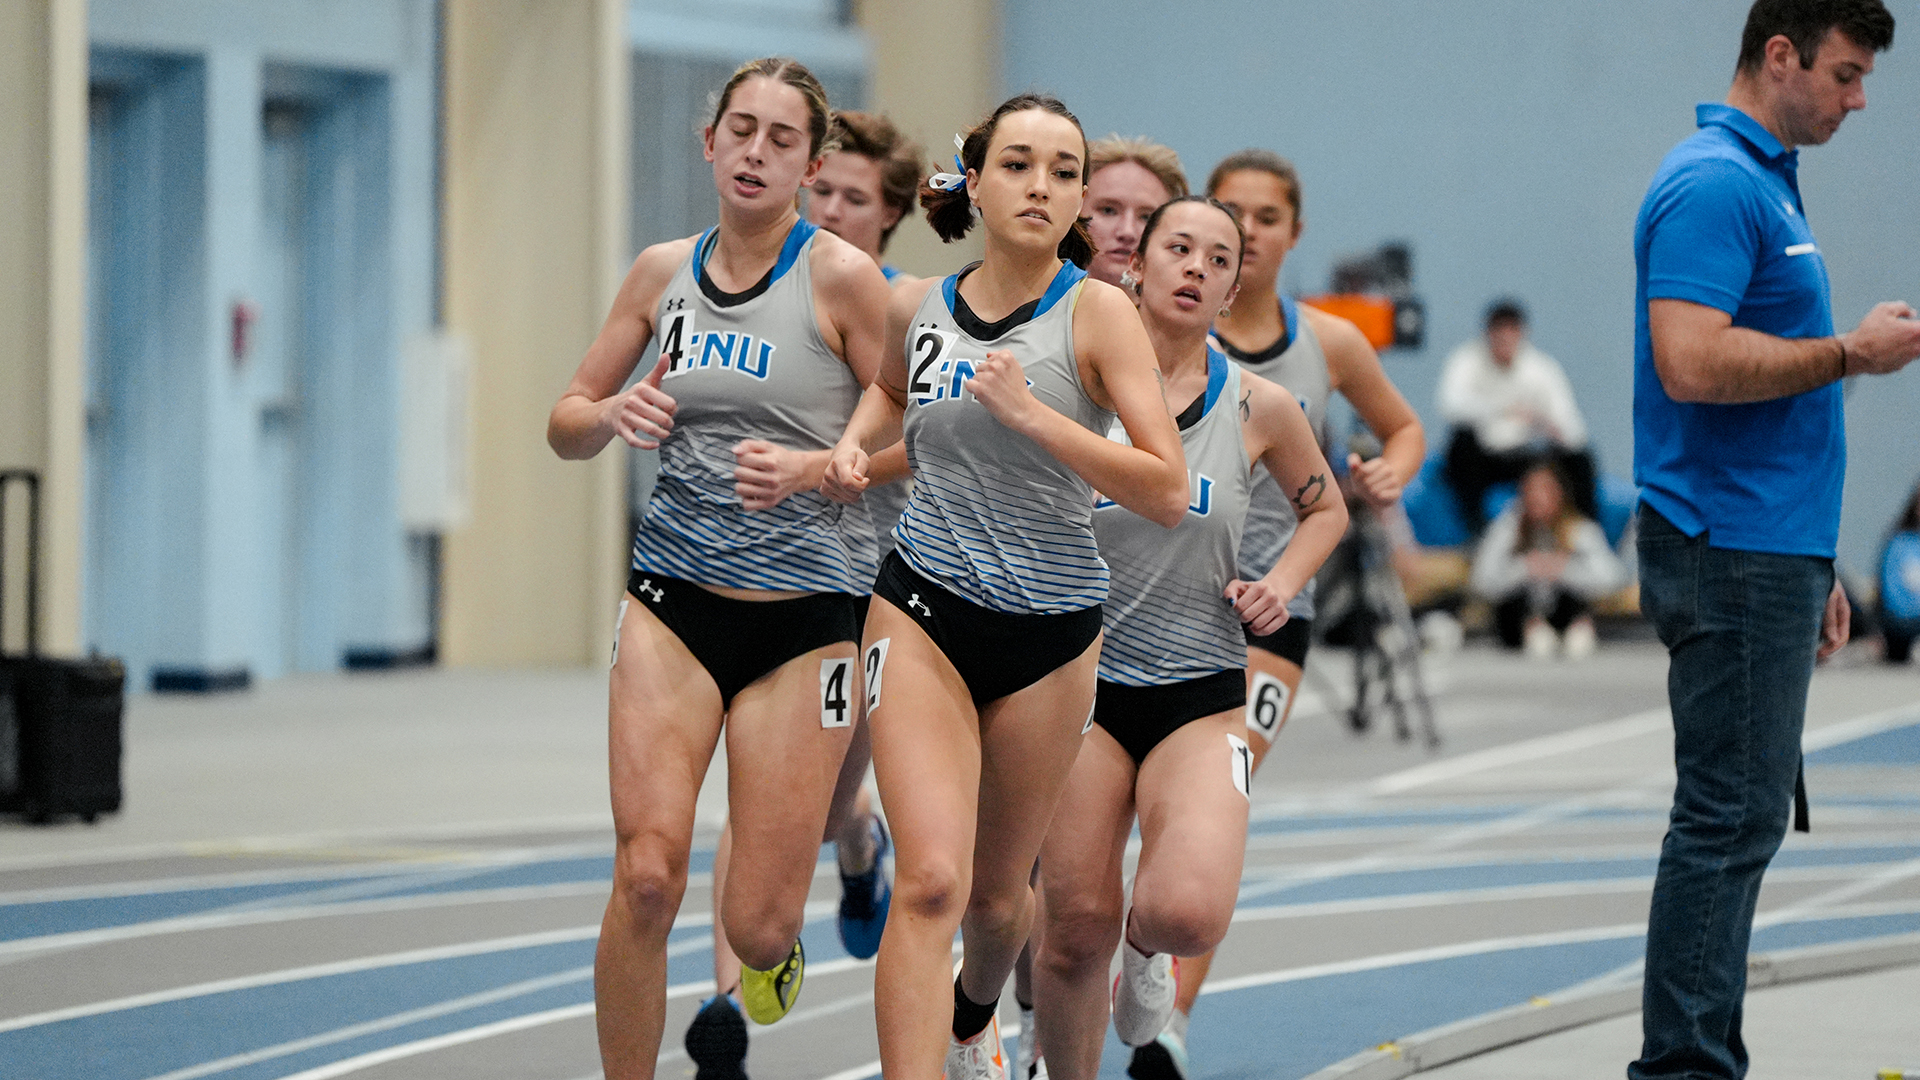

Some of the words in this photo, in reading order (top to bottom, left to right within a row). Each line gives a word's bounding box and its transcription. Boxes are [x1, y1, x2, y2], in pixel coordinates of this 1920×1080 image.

[662, 315, 684, 372] 4
[910, 332, 944, 394] 2
[825, 663, 847, 722] 4
[867, 646, 881, 709] 2
[1255, 683, 1281, 731] 6
[1237, 745, 1250, 796] 1
